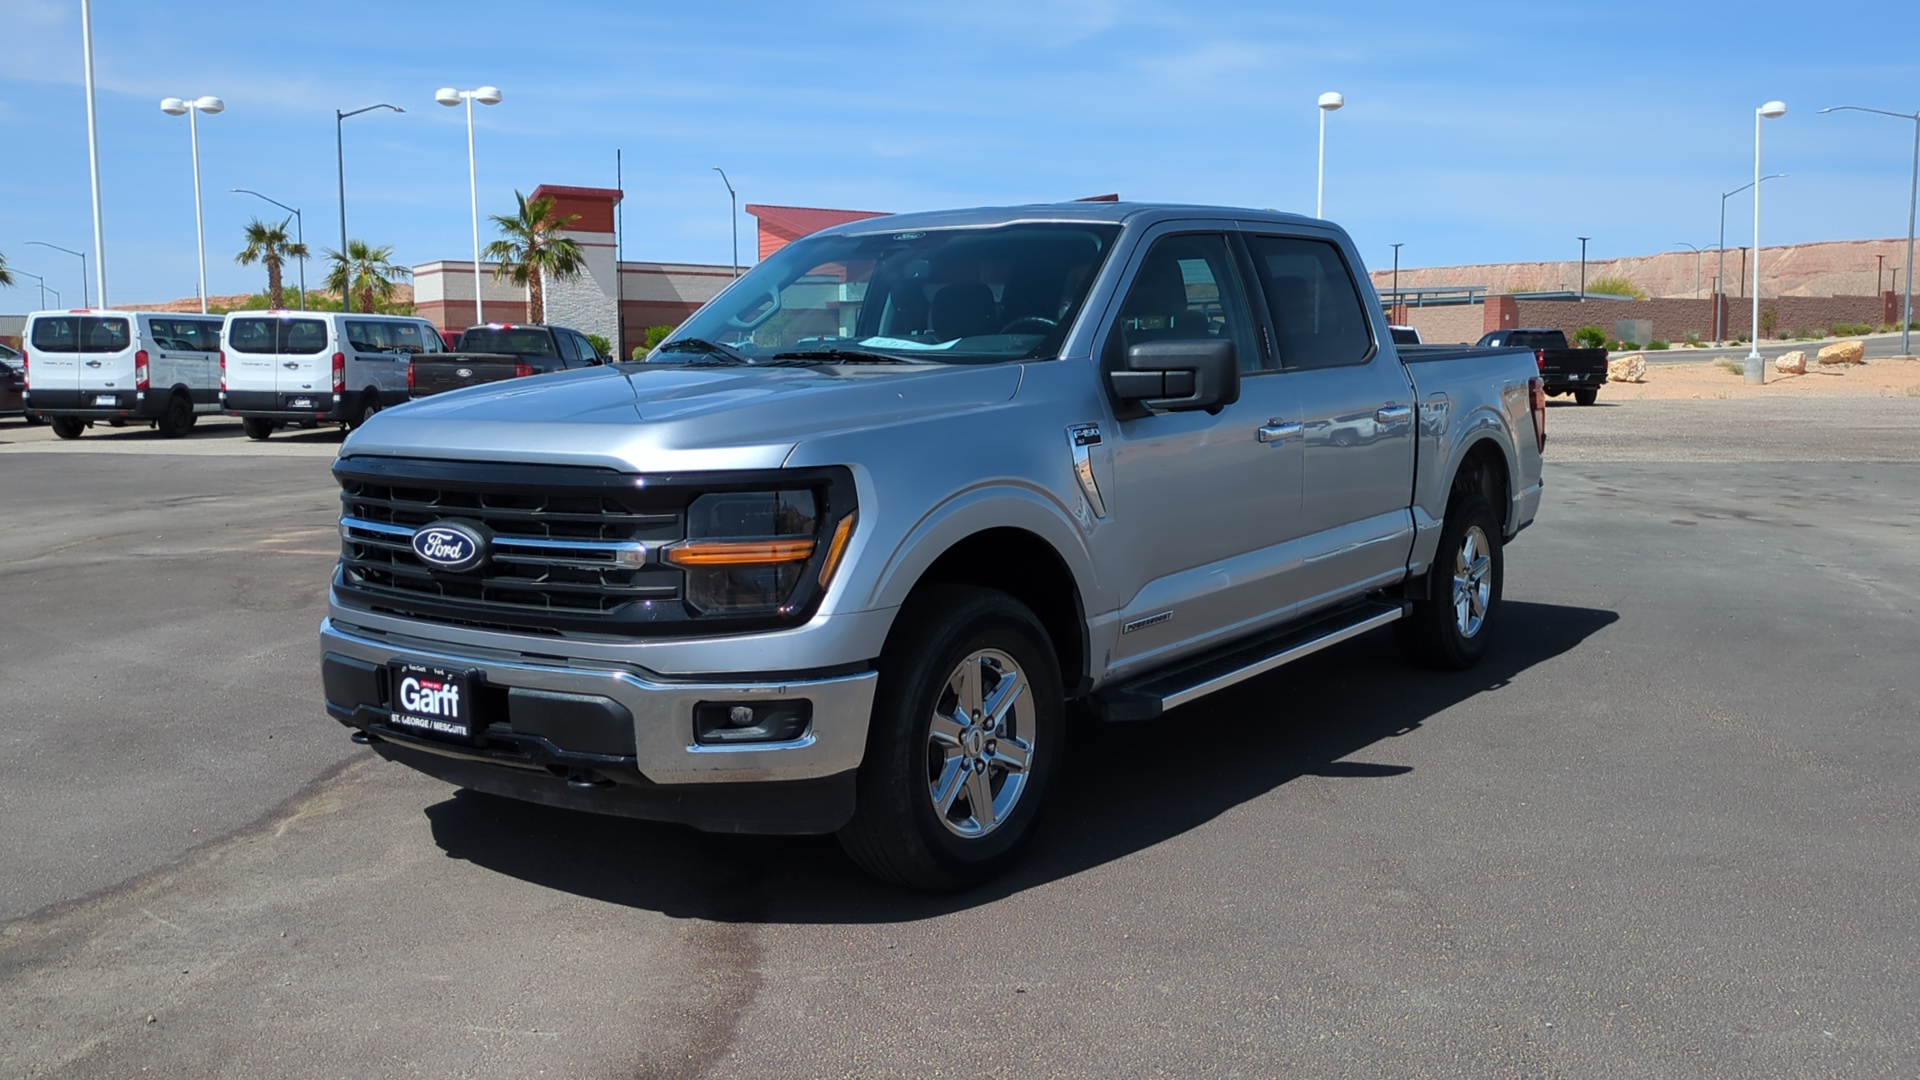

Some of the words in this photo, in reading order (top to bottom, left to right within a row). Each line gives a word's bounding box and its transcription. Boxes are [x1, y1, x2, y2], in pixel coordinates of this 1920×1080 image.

[1073, 427, 1100, 439] F-150
[424, 532, 462, 559] Ford
[400, 677, 459, 718] Garff
[391, 714, 401, 723] ST.
[401, 716, 429, 729] GEORGE
[433, 721, 467, 736] MESQUITE
